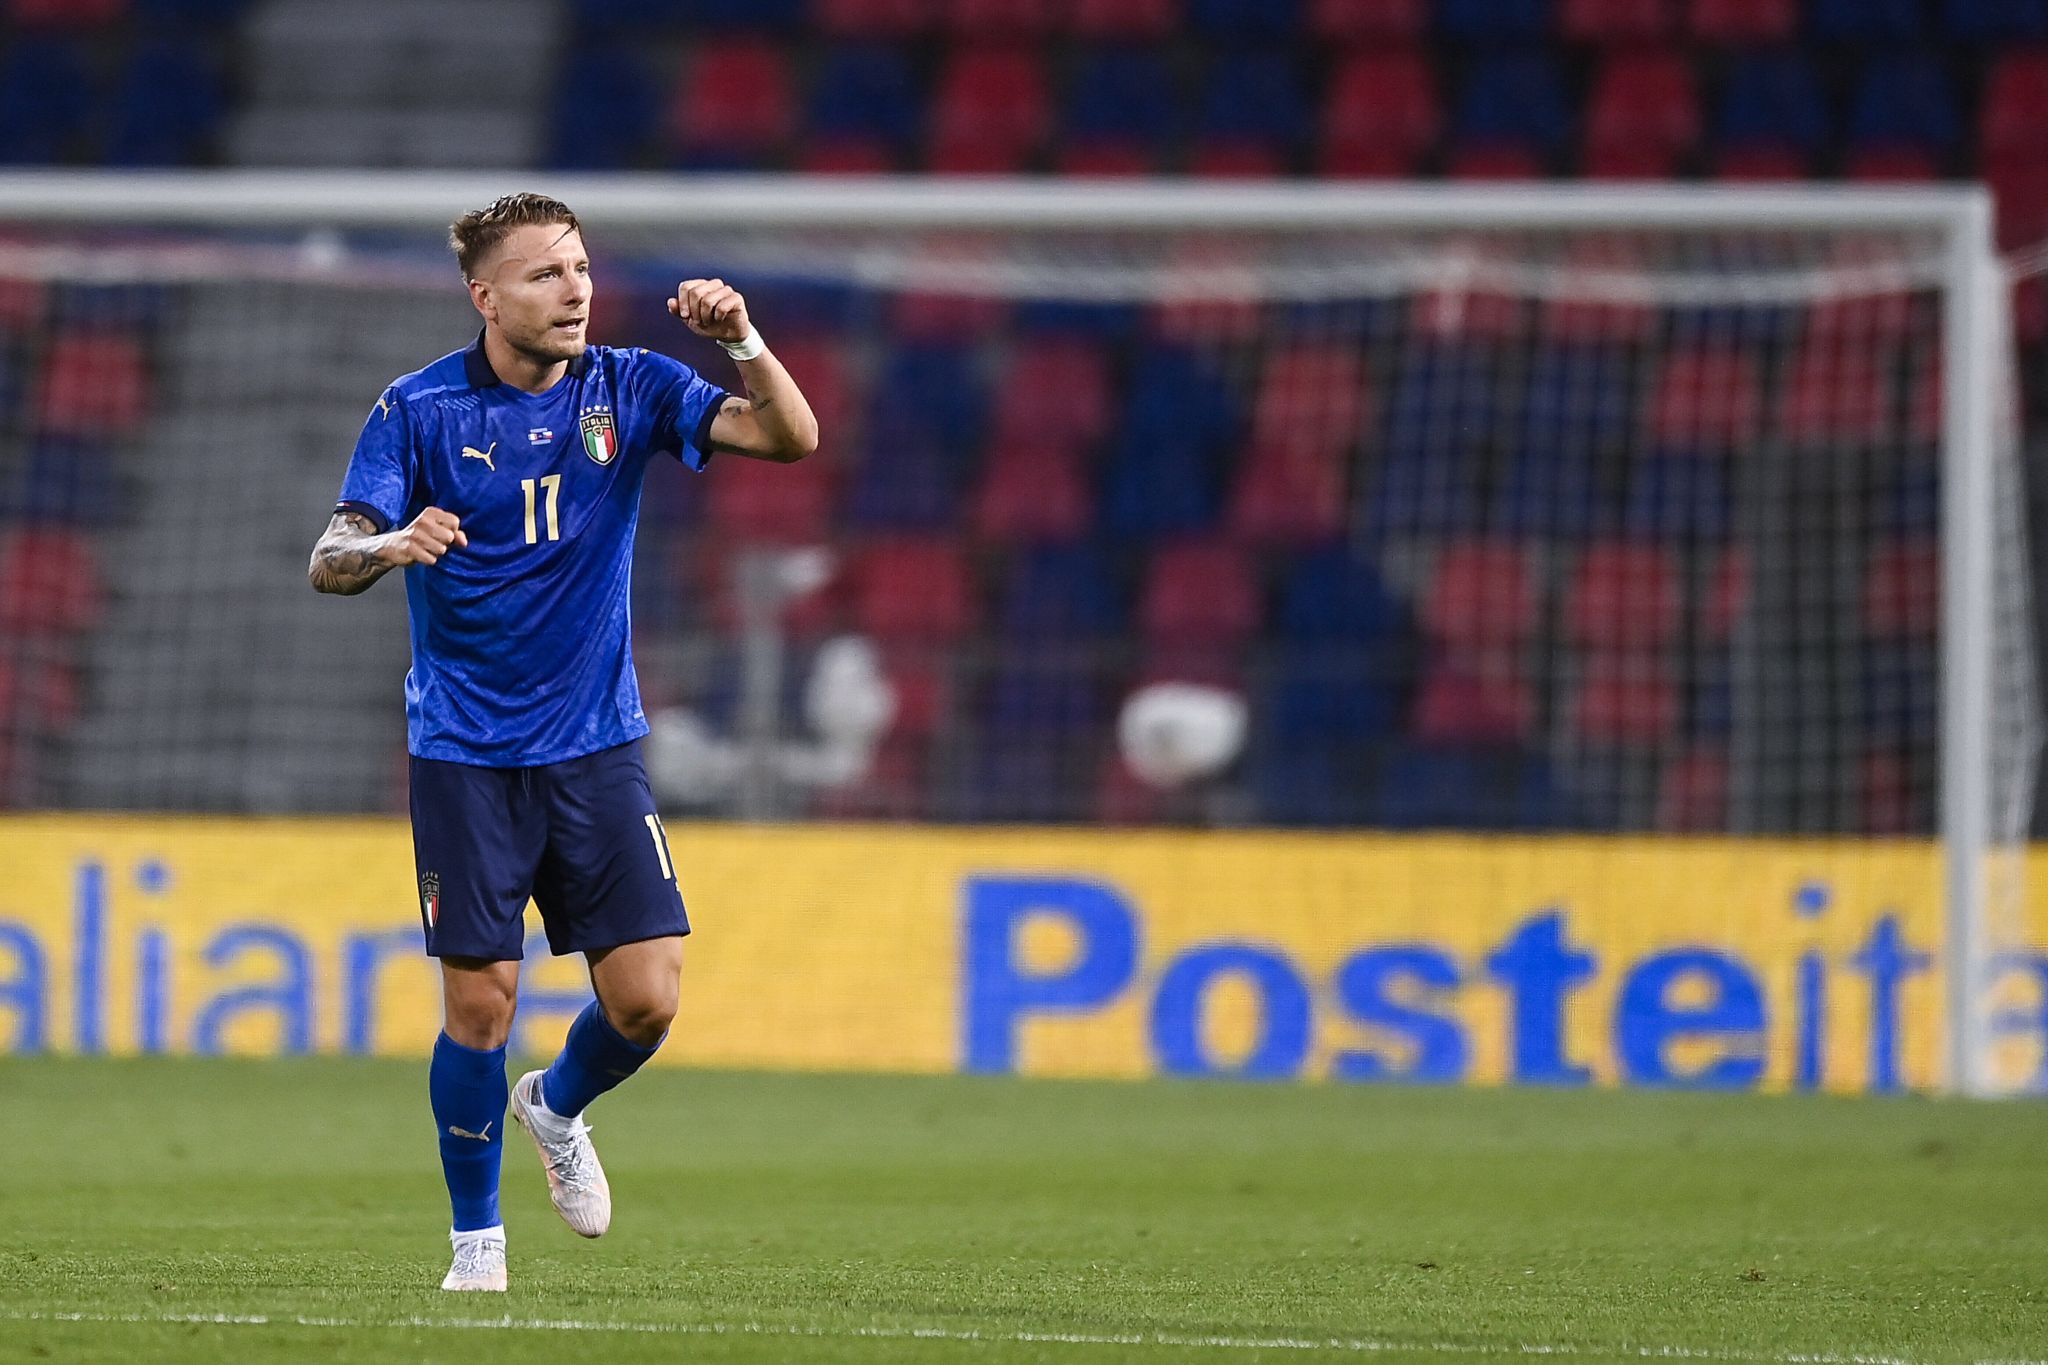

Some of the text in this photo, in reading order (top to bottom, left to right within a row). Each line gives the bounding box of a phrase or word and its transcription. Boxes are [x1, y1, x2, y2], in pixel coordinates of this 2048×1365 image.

[582, 417, 610, 428] ITALIA
[521, 474, 561, 544] 17
[644, 814, 677, 880] 1
